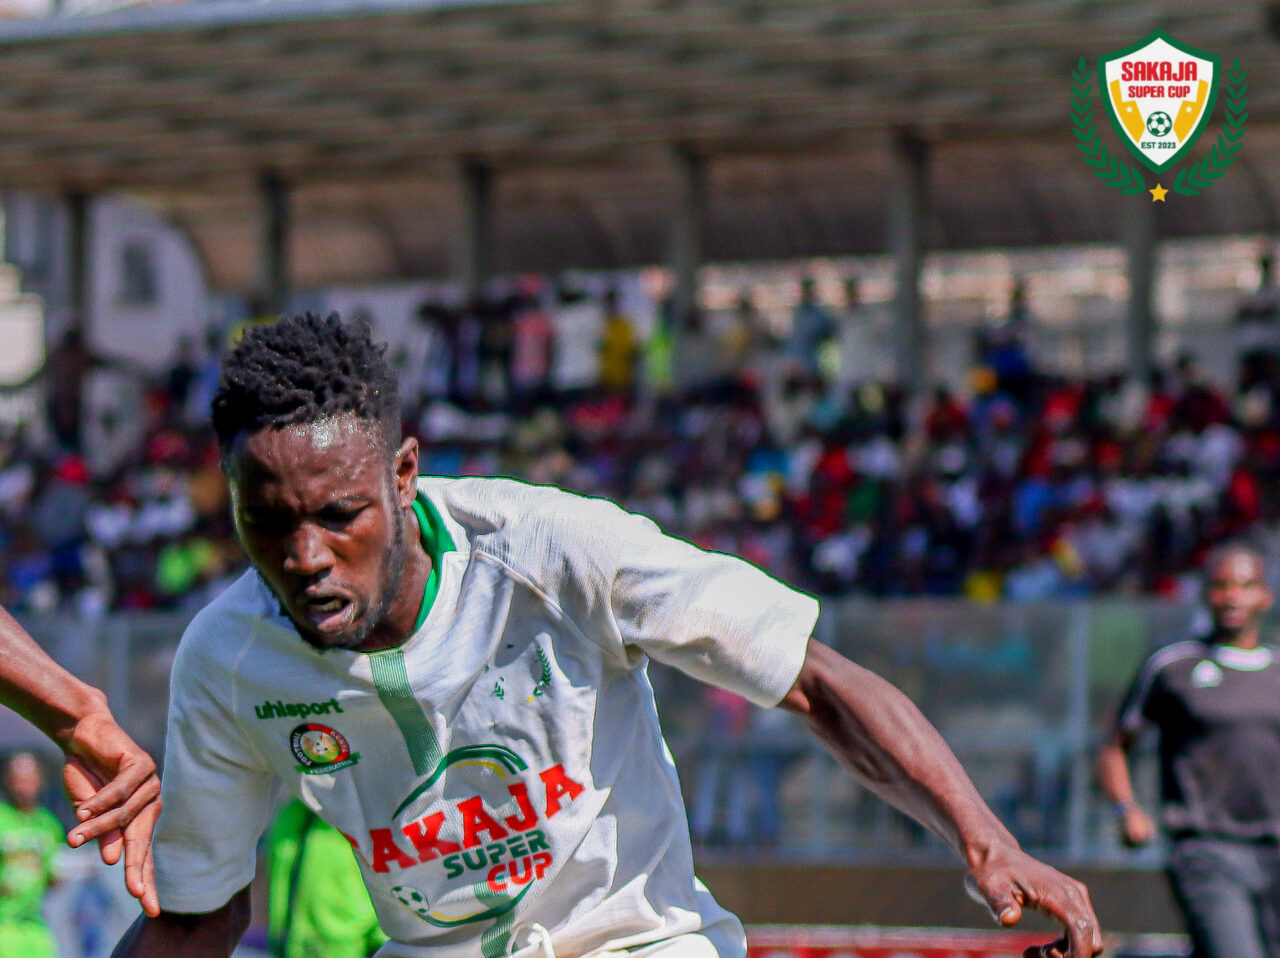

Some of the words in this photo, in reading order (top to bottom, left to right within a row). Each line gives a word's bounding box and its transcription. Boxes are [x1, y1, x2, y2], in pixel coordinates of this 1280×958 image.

[254, 698, 344, 720] uhlsport
[344, 763, 585, 873] AKAJA
[443, 829, 551, 879] SUPER
[486, 852, 553, 892] CUP
